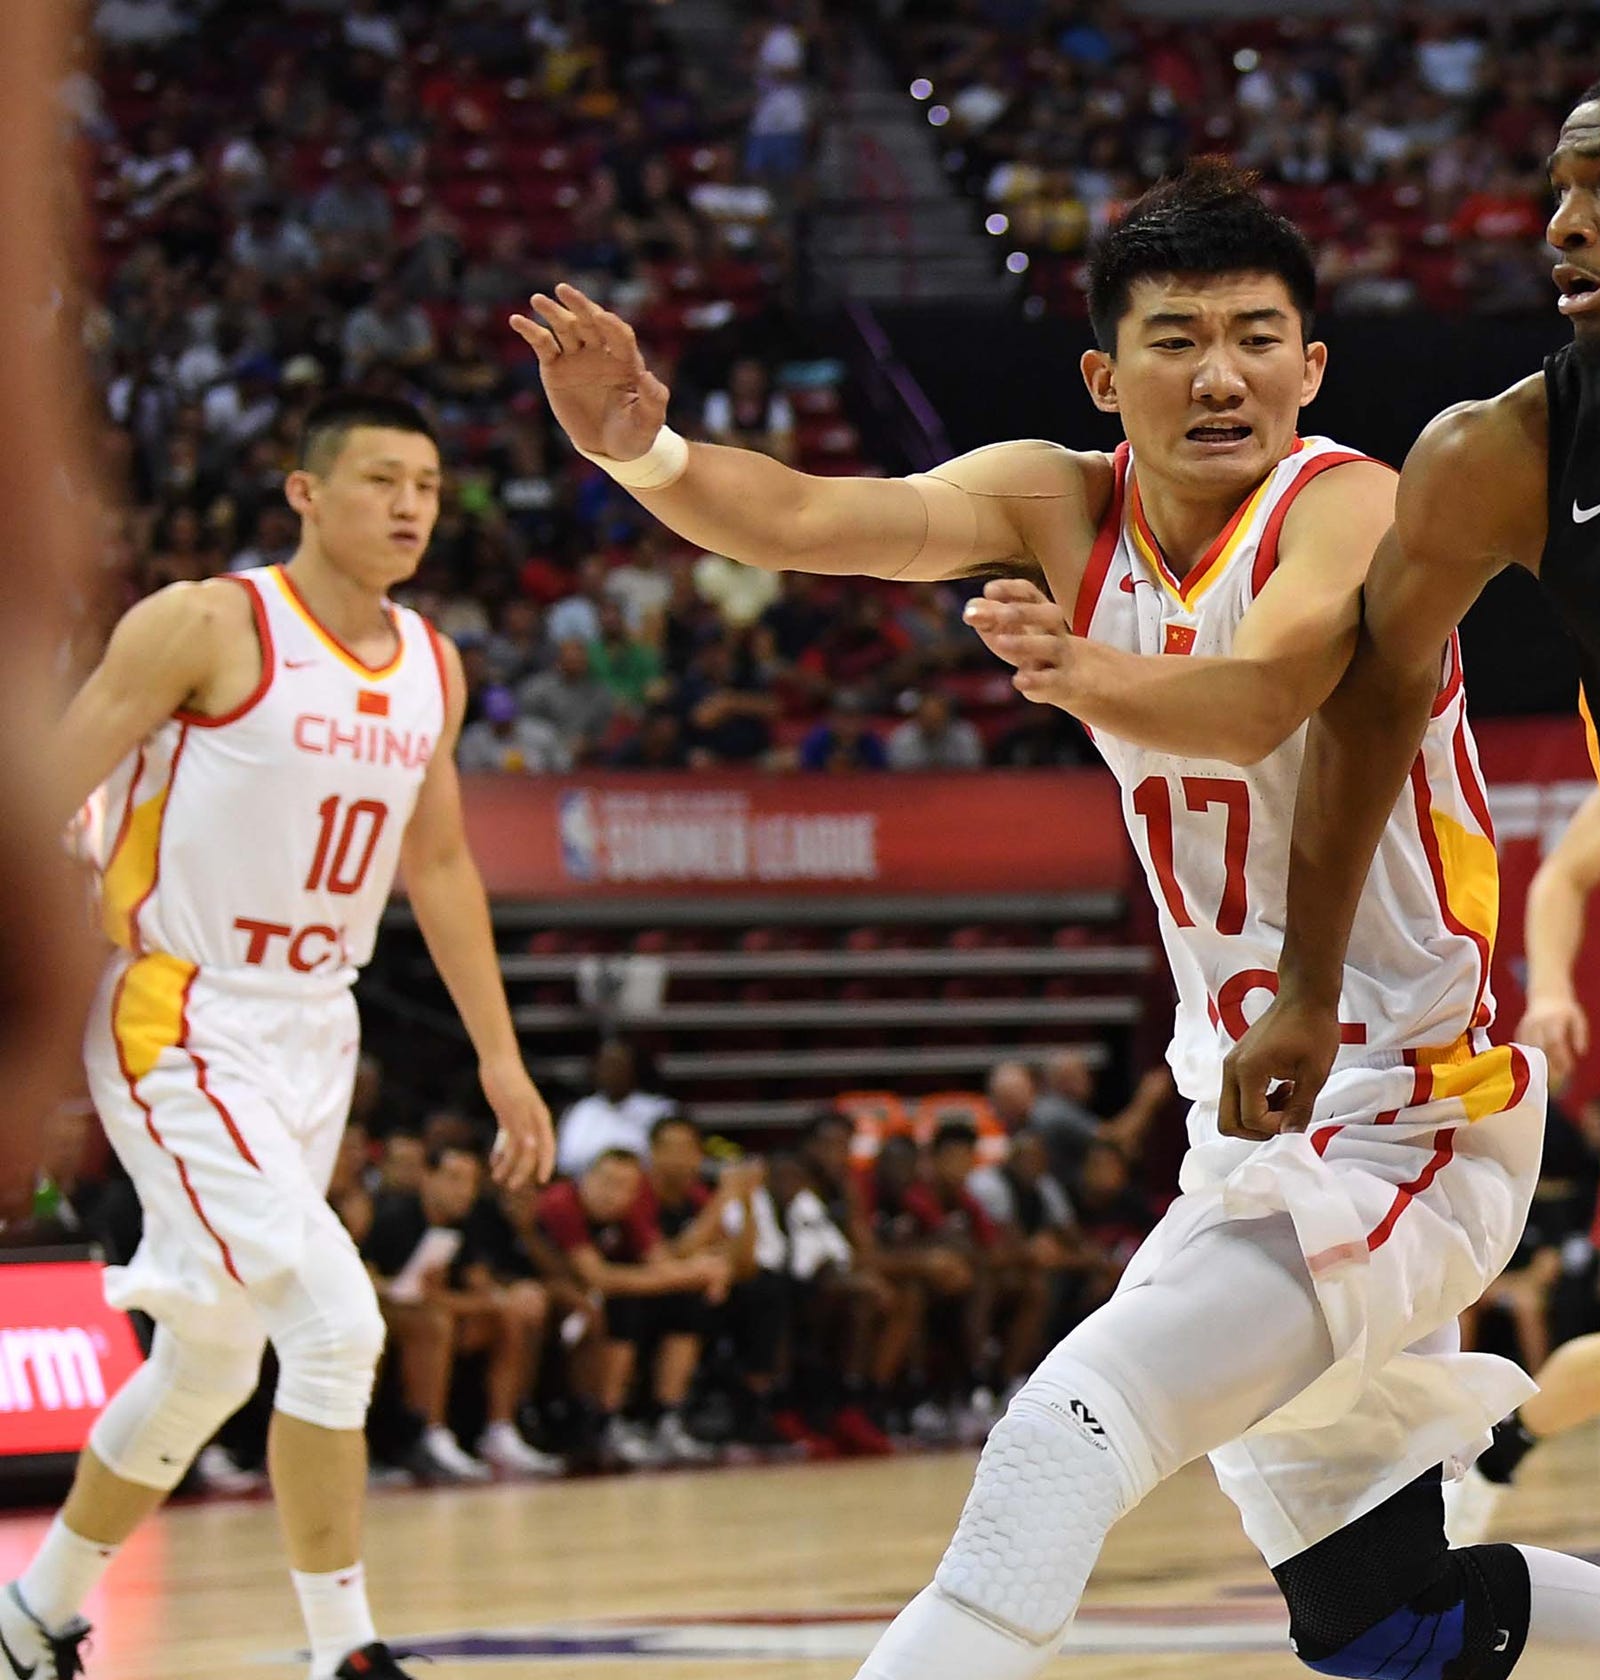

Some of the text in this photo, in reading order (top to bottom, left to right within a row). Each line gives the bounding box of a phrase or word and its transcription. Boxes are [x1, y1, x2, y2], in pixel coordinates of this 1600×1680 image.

[294, 713, 430, 769] CHINA
[305, 793, 389, 895] 10
[1133, 775, 1250, 936] 17
[233, 918, 349, 974] TC
